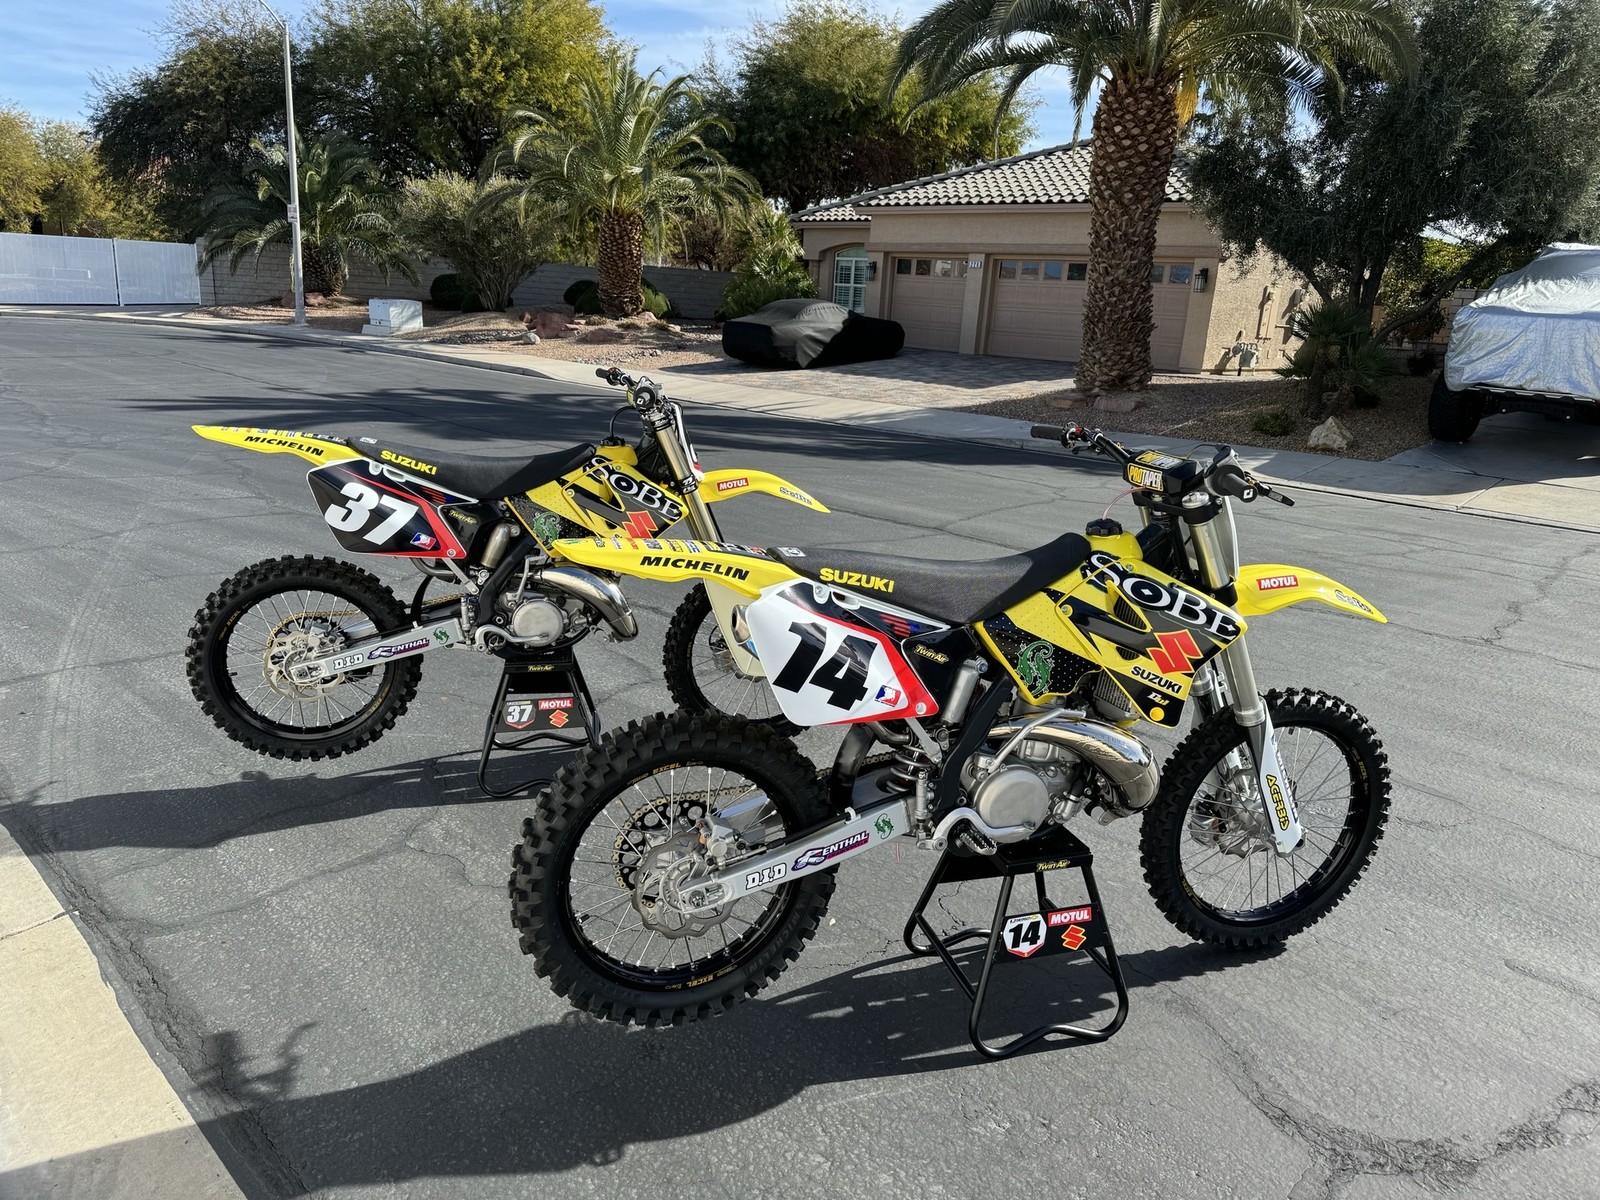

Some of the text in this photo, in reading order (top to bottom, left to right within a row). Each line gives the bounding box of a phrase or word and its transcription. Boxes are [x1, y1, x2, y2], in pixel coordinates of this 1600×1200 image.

[244, 436, 324, 457] MICHELIN
[380, 450, 437, 476] SUZUKI
[719, 479, 748, 491] MOTUL
[1129, 465, 1162, 490] PROTAPER
[324, 482, 419, 545] 37
[640, 556, 750, 581] MICHELIN
[819, 567, 895, 593] SUZUKI
[1260, 577, 1297, 588] MOTUL
[772, 621, 878, 711] 14
[1131, 665, 1183, 694] SUZUKI
[506, 705, 533, 723] 37
[540, 699, 572, 709] MOTUL
[652, 762, 681, 775] EXCEL
[746, 862, 787, 890] D.I.D
[1050, 909, 1090, 925] MOTUL
[1008, 920, 1041, 949] 14
